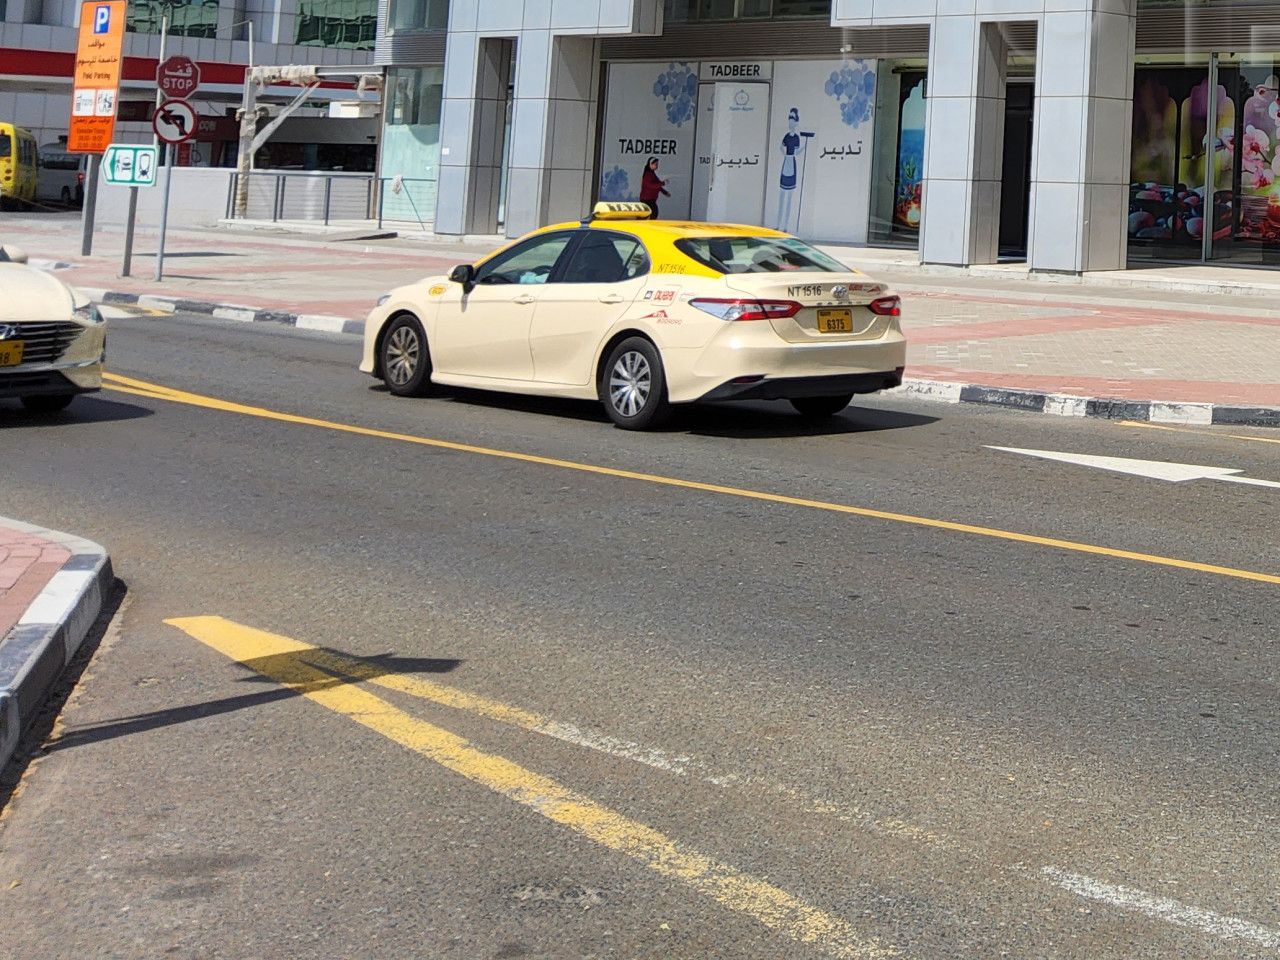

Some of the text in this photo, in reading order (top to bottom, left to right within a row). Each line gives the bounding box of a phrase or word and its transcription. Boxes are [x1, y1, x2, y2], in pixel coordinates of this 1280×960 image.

[165, 63, 193, 77] قف
[710, 64, 760, 77] TADBEER
[163, 77, 193, 90] STOP
[619, 138, 677, 155] TADBEER
[820, 140, 863, 161] تدبير
[607, 203, 651, 213] TAXI
